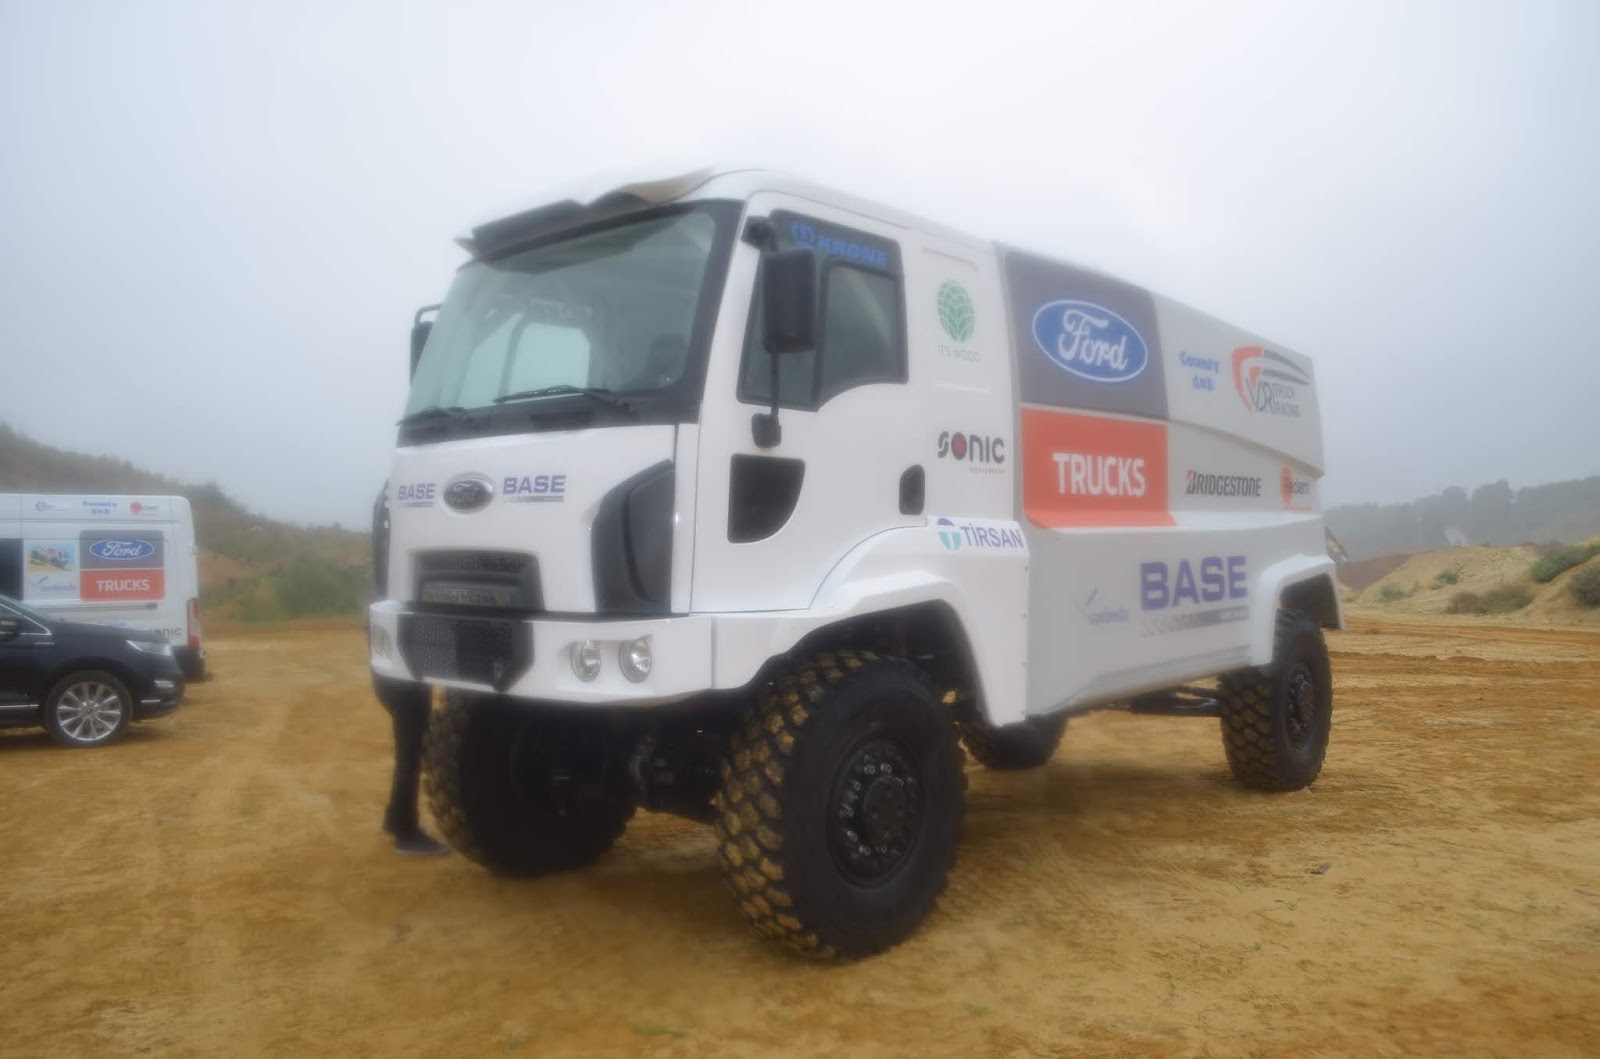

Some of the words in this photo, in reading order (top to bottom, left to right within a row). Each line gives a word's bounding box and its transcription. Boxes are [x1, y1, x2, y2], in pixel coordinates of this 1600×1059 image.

[1058, 309, 1128, 370] Ford
[503, 474, 567, 495] BASE
[1052, 452, 1146, 497] TRUCKS
[1185, 470, 1262, 497] BRIDGESTONE
[399, 483, 436, 500] BASE
[102, 541, 142, 557] Ford
[96, 579, 151, 592] TRUCKS
[1140, 555, 1248, 611] BASE
